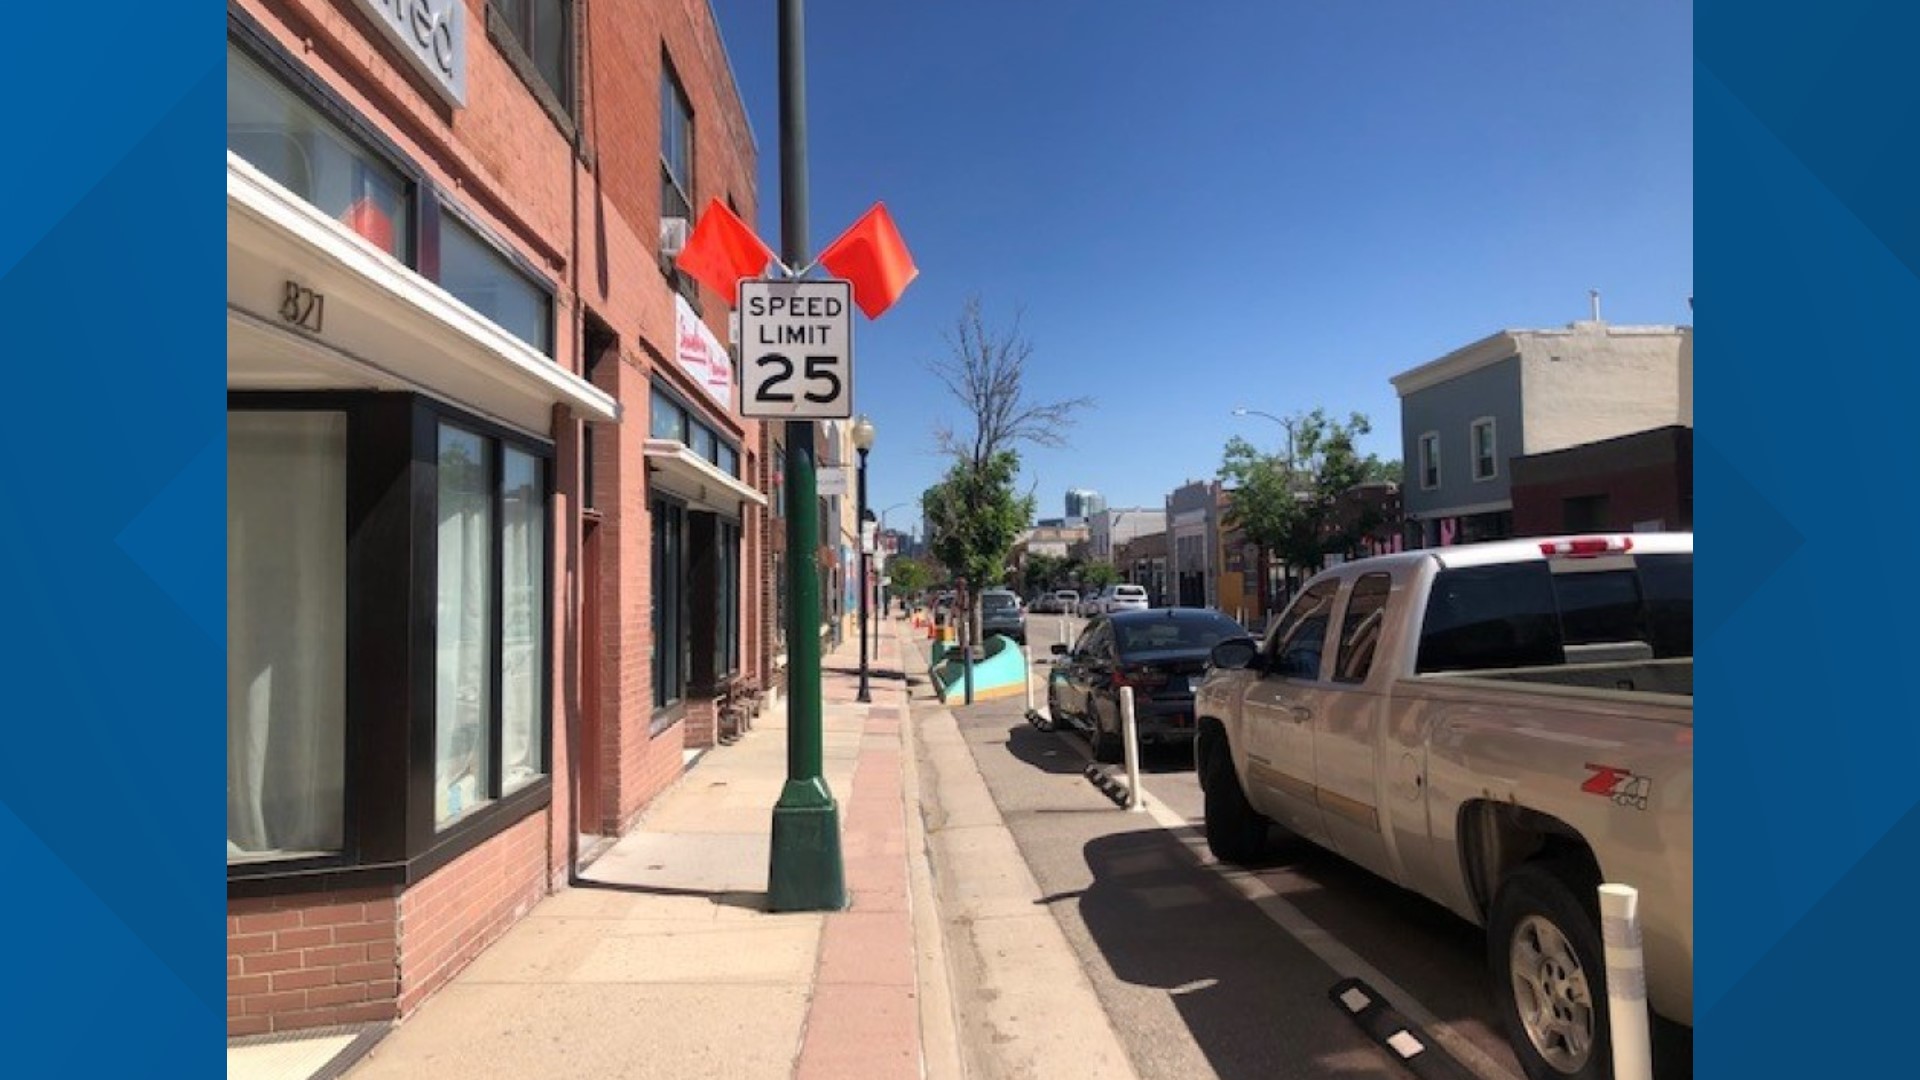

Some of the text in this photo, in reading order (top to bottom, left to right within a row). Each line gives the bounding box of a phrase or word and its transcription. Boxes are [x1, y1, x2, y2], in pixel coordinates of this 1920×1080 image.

[278, 280, 324, 333] 821
[749, 296, 842, 317] SPEED
[759, 325, 831, 344] LIMIT
[755, 352, 842, 403] 25
